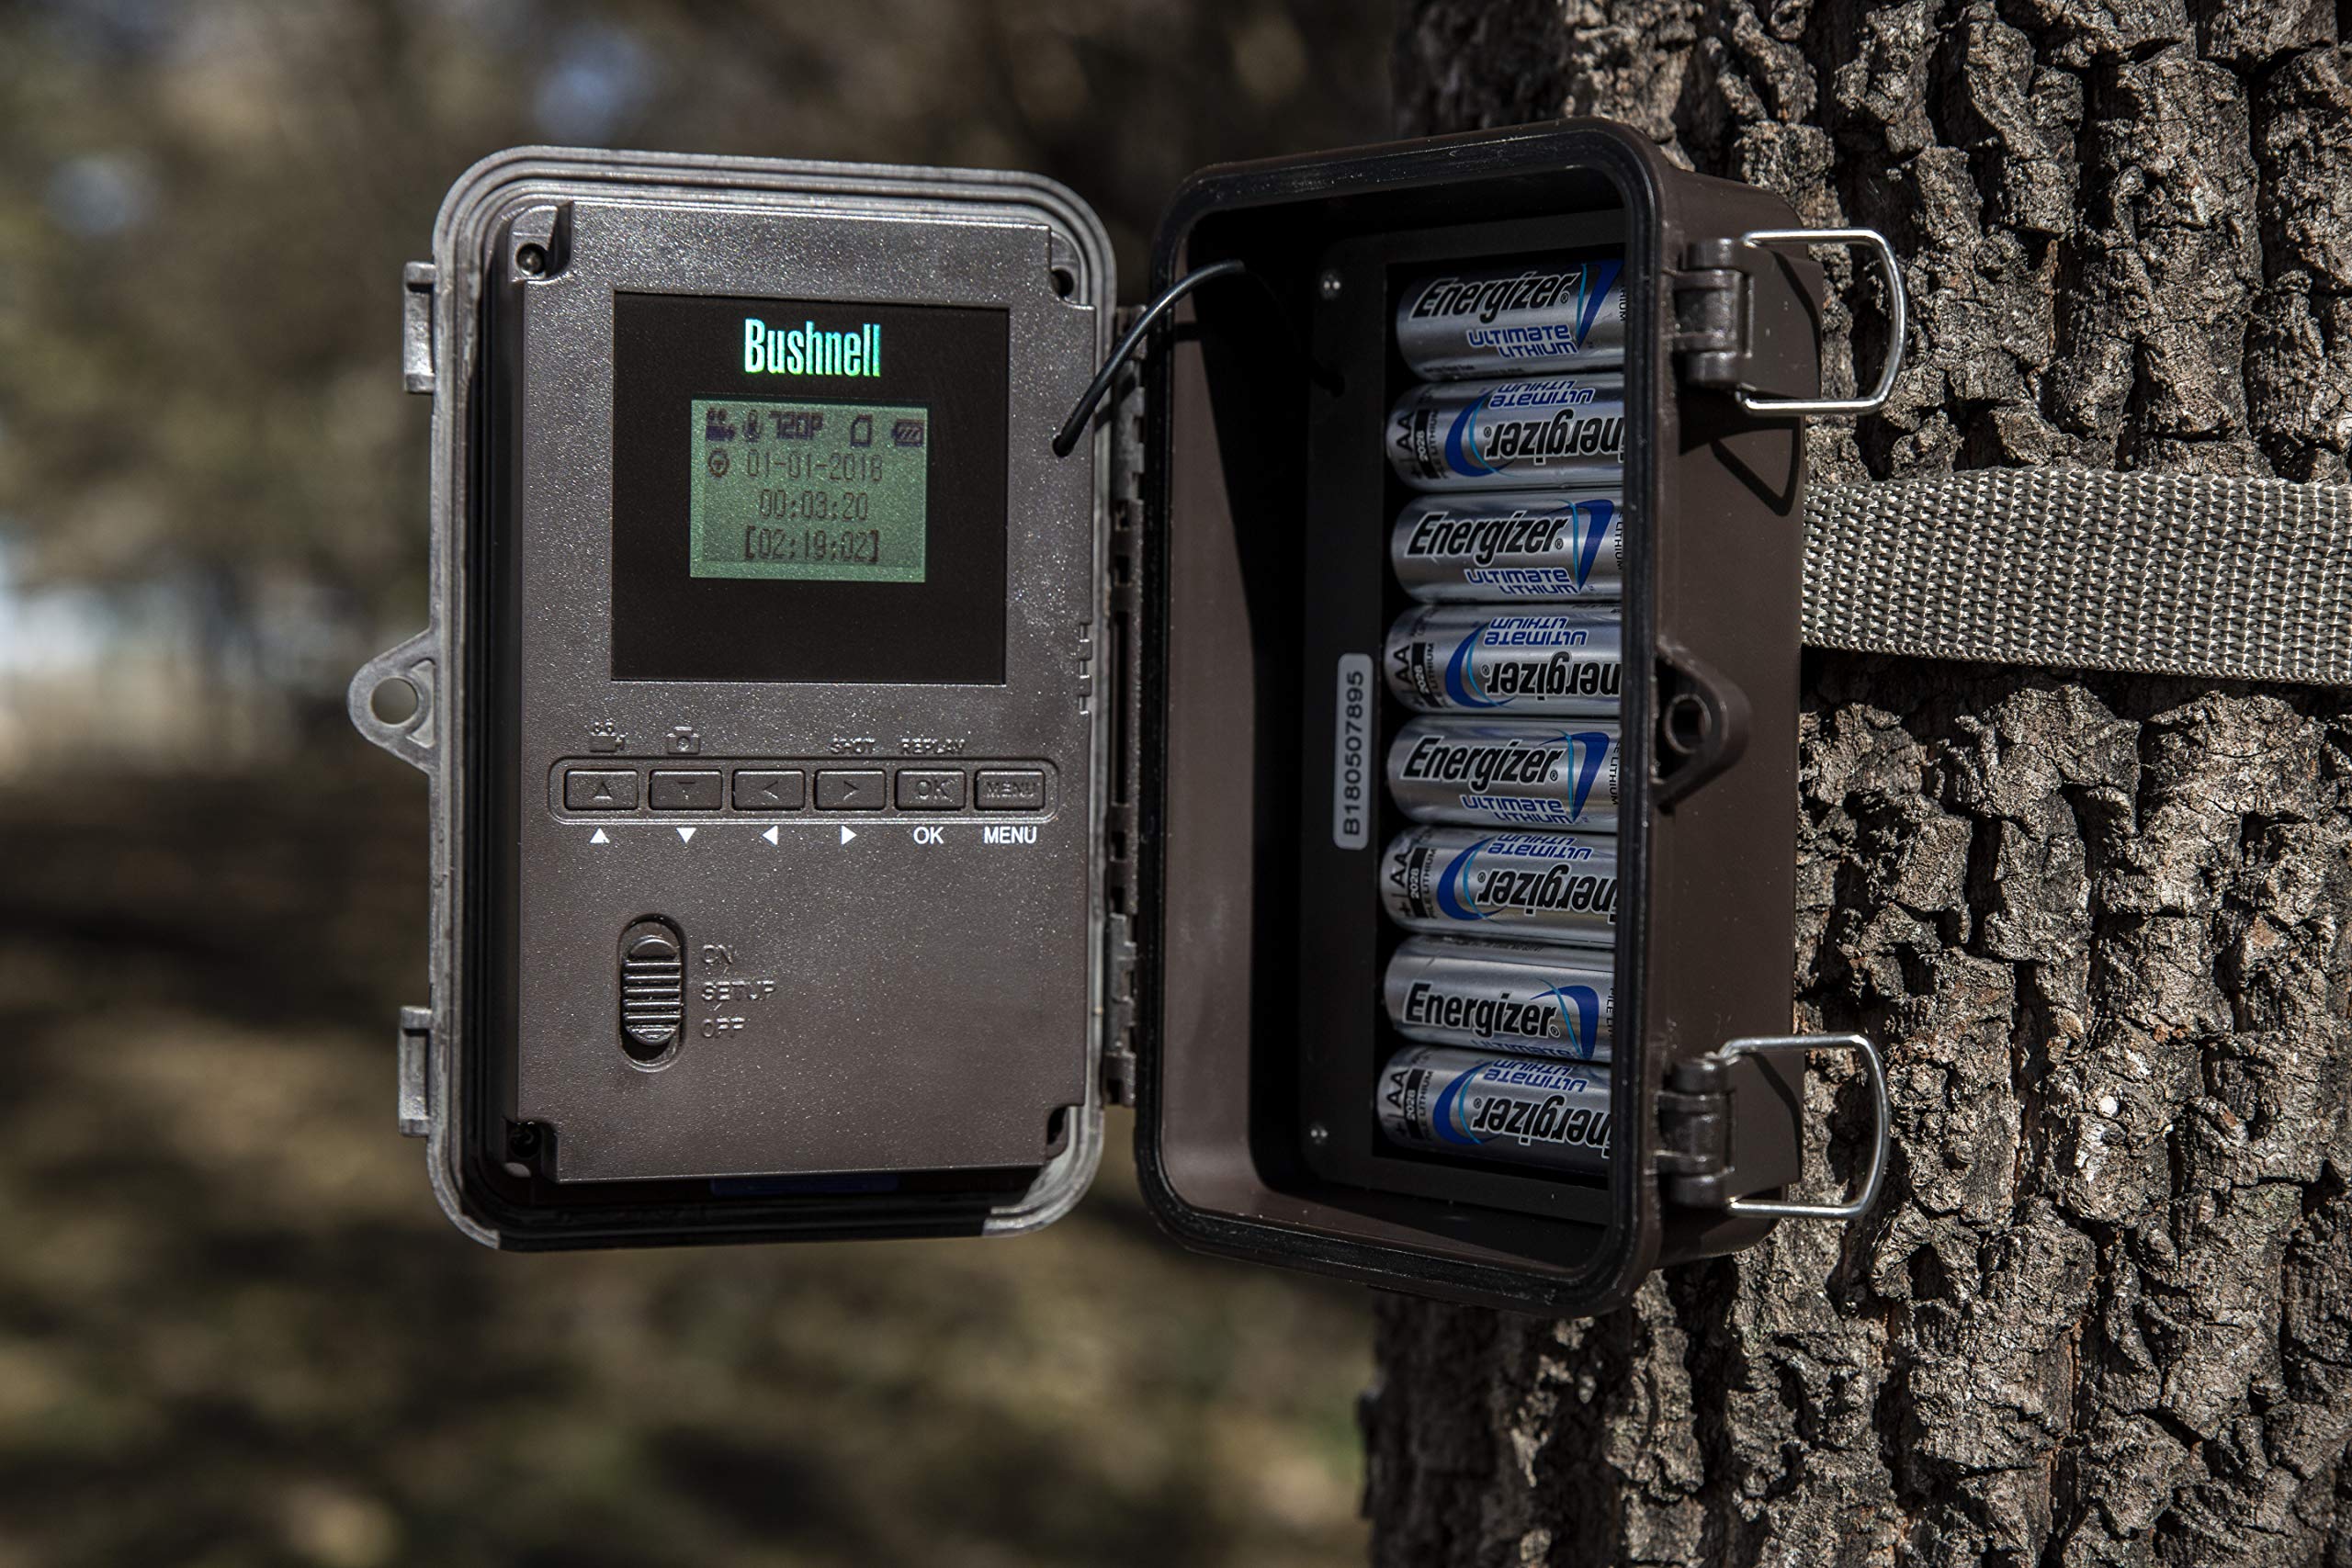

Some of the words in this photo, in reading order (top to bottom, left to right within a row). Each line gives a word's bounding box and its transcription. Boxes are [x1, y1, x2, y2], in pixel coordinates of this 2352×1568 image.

[1410, 271, 1580, 323] Energizer
[744, 318, 881, 378] Bushnell
[1498, 343, 1578, 358] LITHIUM
[1498, 379, 1577, 393] LITHIUM
[1396, 412, 1415, 452] AA
[746, 449, 883, 482] 01-01-2018
[760, 489, 868, 521] 00:03:20
[1406, 511, 1568, 566] Energizer
[1499, 583, 1579, 596] LITHIUM
[1489, 617, 1568, 629] LITHIUM
[1393, 645, 1412, 685] AA
[1487, 650, 1622, 701] nergizer
[1342, 671, 1363, 835] B180507895
[1401, 736, 1565, 794] Energizer
[1495, 812, 1574, 825] LITHIUM
[912, 826, 944, 844] OK
[983, 826, 1037, 844] MENU
[1498, 833, 1577, 846] LITHIUM
[1390, 848, 1412, 888] AA
[1410, 867, 1420, 899] 2028
[1422, 848, 1436, 894] LITHIUM
[701, 944, 735, 965] ON
[701, 980, 776, 1002] SETUP
[1403, 981, 1558, 1038] Energizer
[700, 1017, 746, 1040] OFF
[1494, 1059, 1572, 1077] LITHIUM
[1386, 1069, 1408, 1109] AA
[1405, 1089, 1417, 1122] 2028
